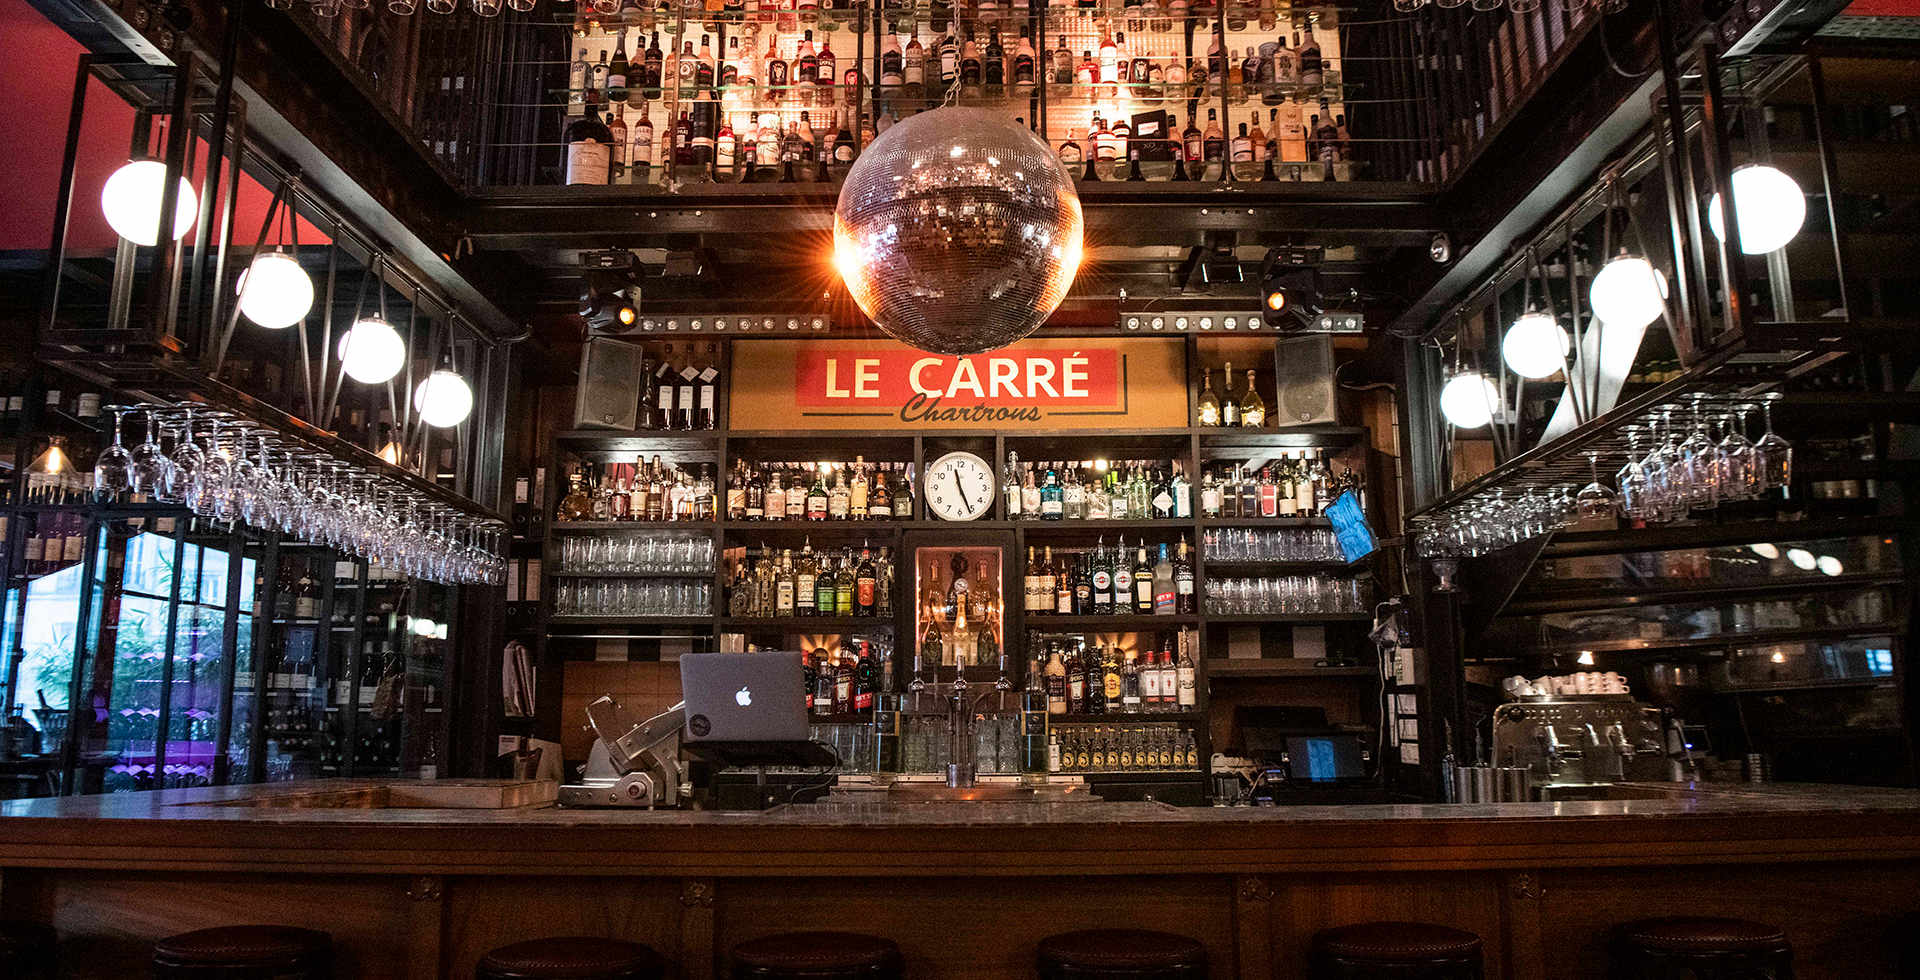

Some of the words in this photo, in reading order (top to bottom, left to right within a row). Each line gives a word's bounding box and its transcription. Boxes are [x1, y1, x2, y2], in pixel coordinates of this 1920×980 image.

[825, 358, 880, 398] LE
[908, 351, 1089, 398] CARRÉ
[900, 392, 1043, 422] Chartrons
[957, 460, 965, 468] 12
[937, 472, 946, 480] 10
[978, 472, 984, 480] 2
[936, 496, 942, 504] 8
[977, 496, 983, 504] 4
[957, 508, 963, 516] 6
[970, 504, 975, 512] 5
